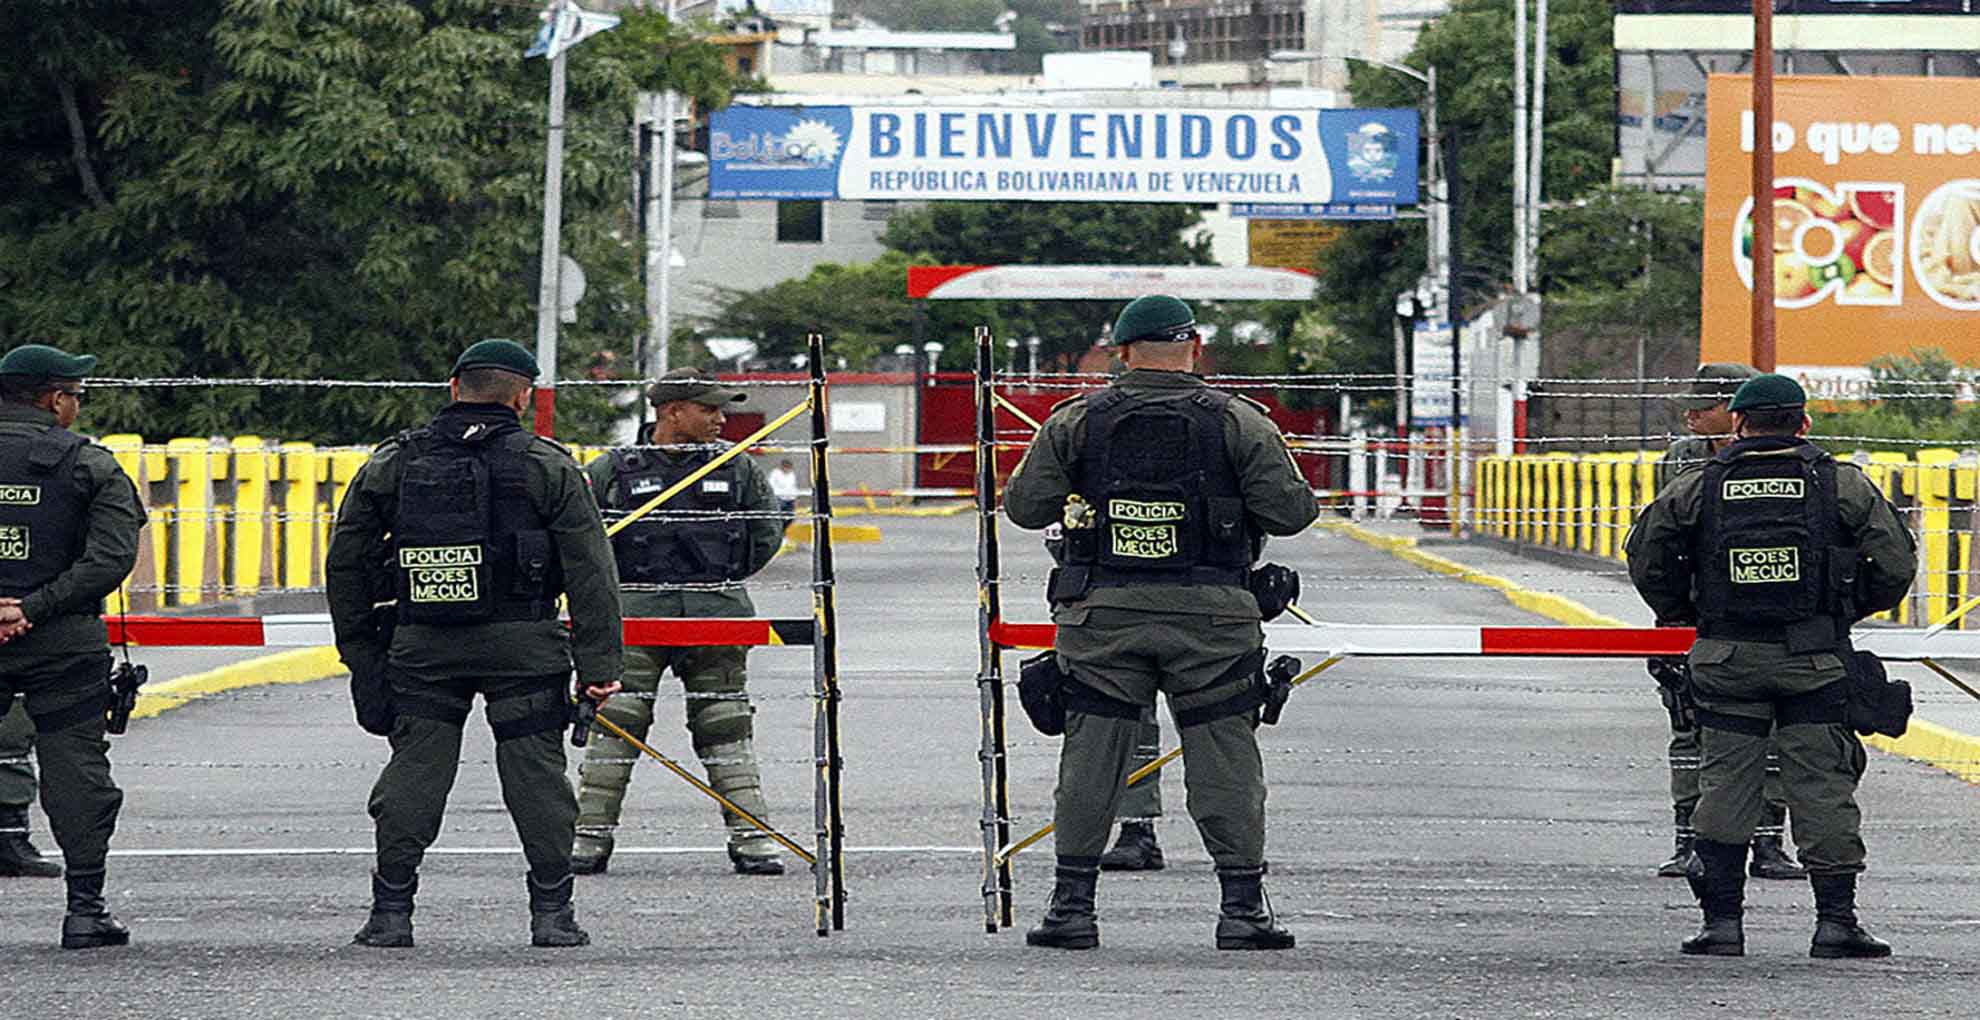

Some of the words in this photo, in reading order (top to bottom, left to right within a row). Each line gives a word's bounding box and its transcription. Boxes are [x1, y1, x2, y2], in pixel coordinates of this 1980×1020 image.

[869, 112, 1302, 161] BIENVENIDOS
[1806, 122, 1900, 164] que
[1912, 122, 1980, 155] ne
[870, 166, 987, 191] REPÚBLICA
[997, 170, 1139, 192] BOLIVARIANA
[1149, 172, 1174, 192] DE
[1183, 172, 1301, 193] VENEZUELA
[1729, 482, 1797, 497] POLICIA
[1115, 503, 1178, 518] POLICIA
[1119, 527, 1169, 541] GOES
[1116, 539, 1172, 555] MECUC
[405, 550, 474, 564] POLICIA
[1738, 551, 1790, 564] GOES
[418, 570, 468, 583] GOES
[1735, 564, 1795, 580] MECUC
[415, 583, 473, 599] MECUC
